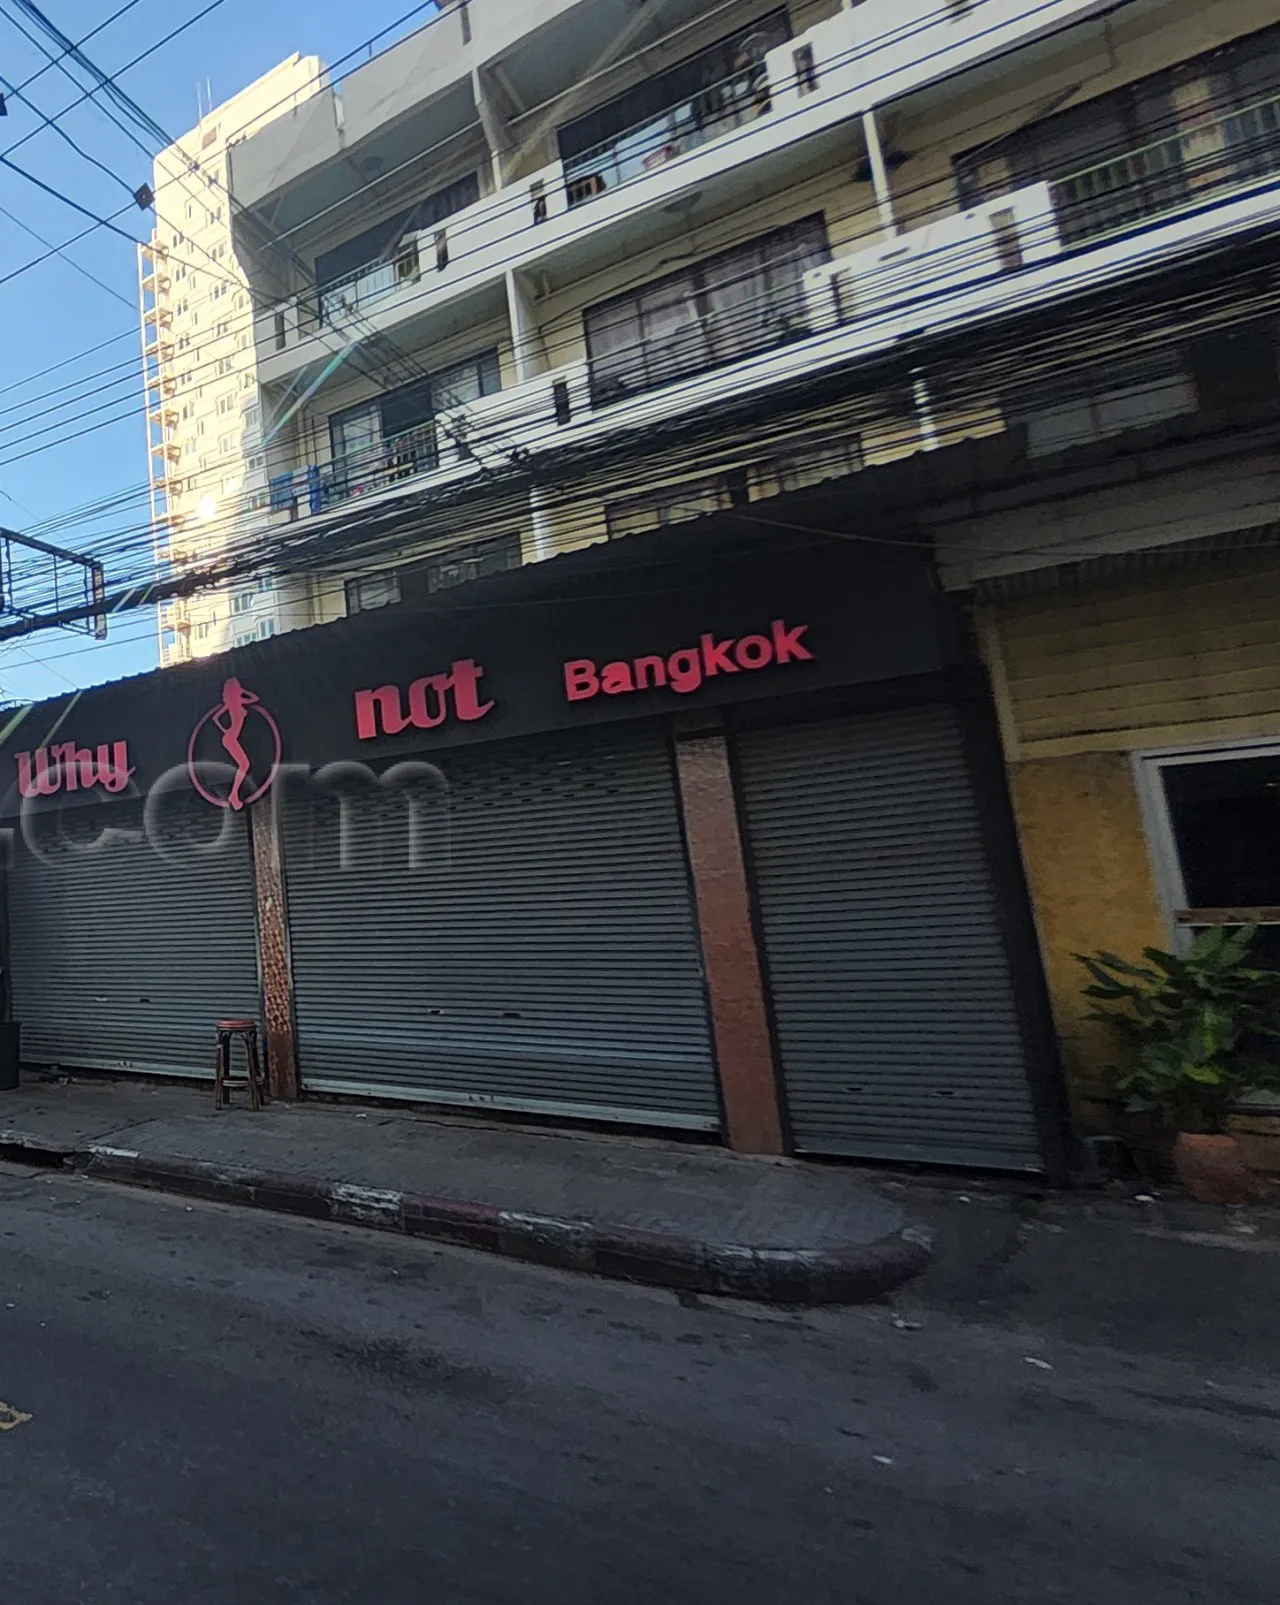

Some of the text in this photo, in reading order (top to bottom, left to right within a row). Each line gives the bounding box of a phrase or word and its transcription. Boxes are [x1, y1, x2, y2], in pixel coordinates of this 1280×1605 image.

[14, 618, 814, 797] Why not Bangkok
